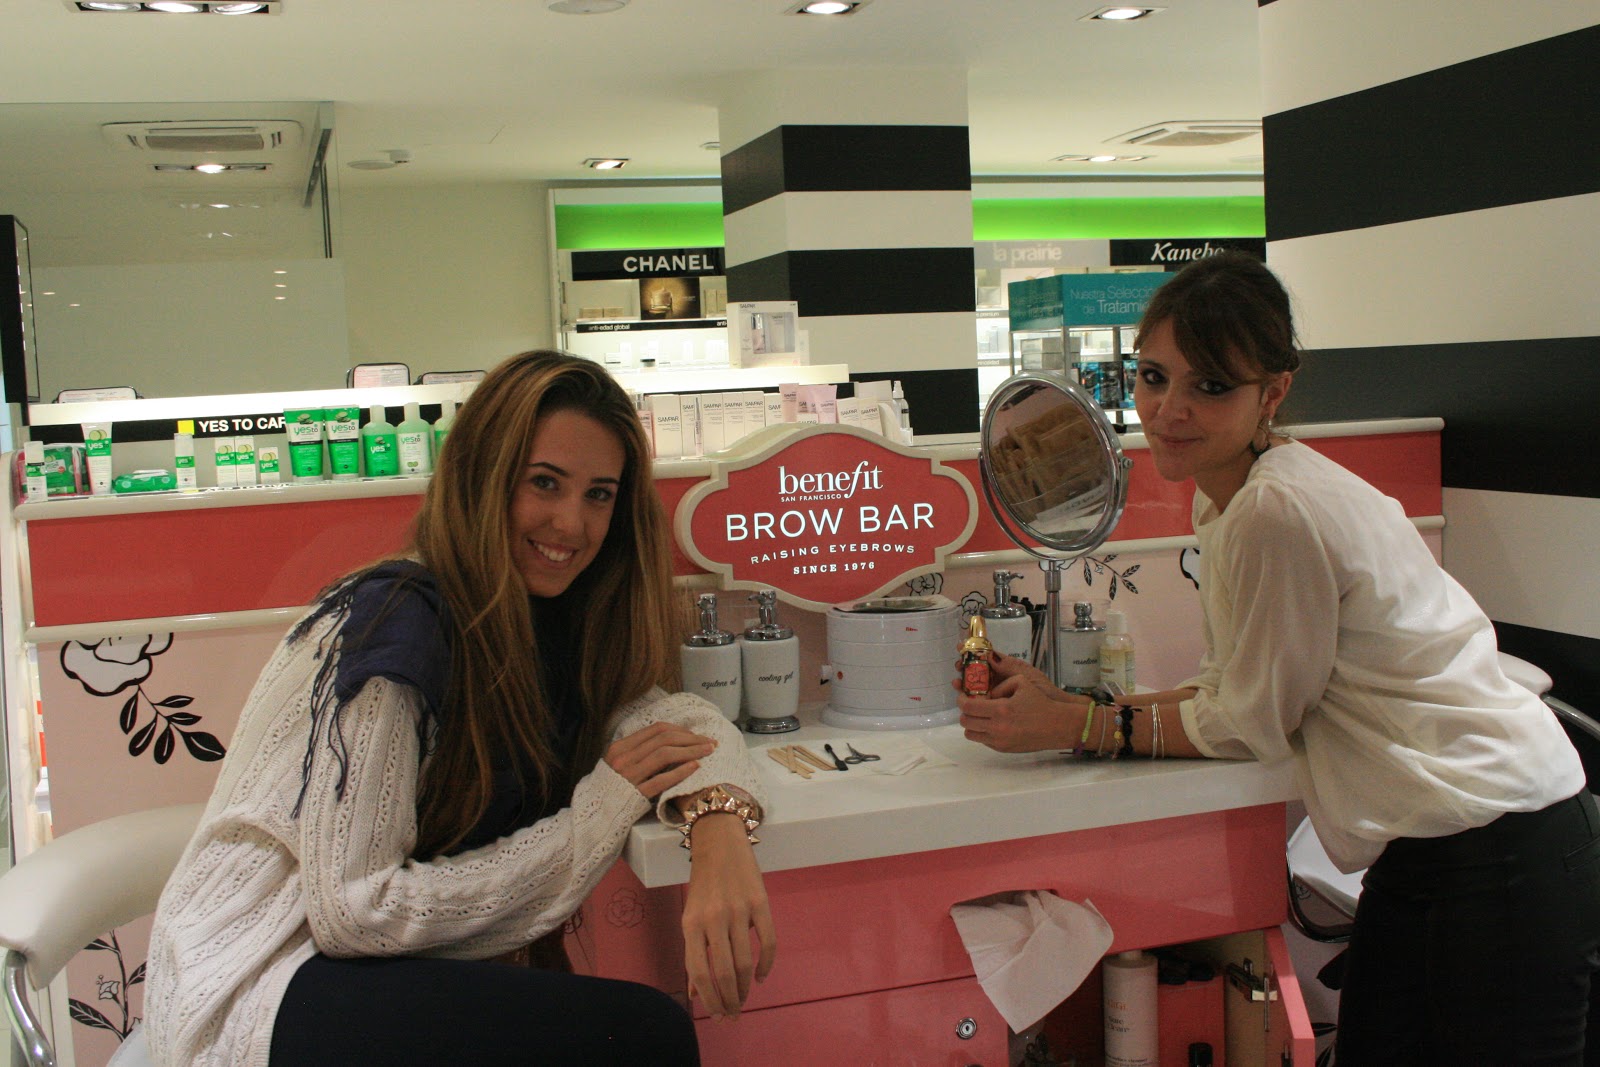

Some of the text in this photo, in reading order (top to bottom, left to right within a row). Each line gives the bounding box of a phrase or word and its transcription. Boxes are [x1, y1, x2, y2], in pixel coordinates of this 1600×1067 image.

[993, 242, 1062, 267] la prairie
[623, 254, 714, 272] CHANEL
[1070, 289, 1106, 299] Nuestra
[1083, 305, 1095, 314] de
[614, 323, 631, 332] global
[199, 420, 229, 433] YES
[232, 419, 254, 431] TO
[657, 415, 679, 423] SAMPAR
[778, 460, 883, 499] benefit
[726, 502, 934, 541] BROW BAR
[751, 543, 915, 565] RAISING EYEBROWS
[793, 561, 875, 575] SINCE 1976
[758, 671, 793, 684] cooling gel
